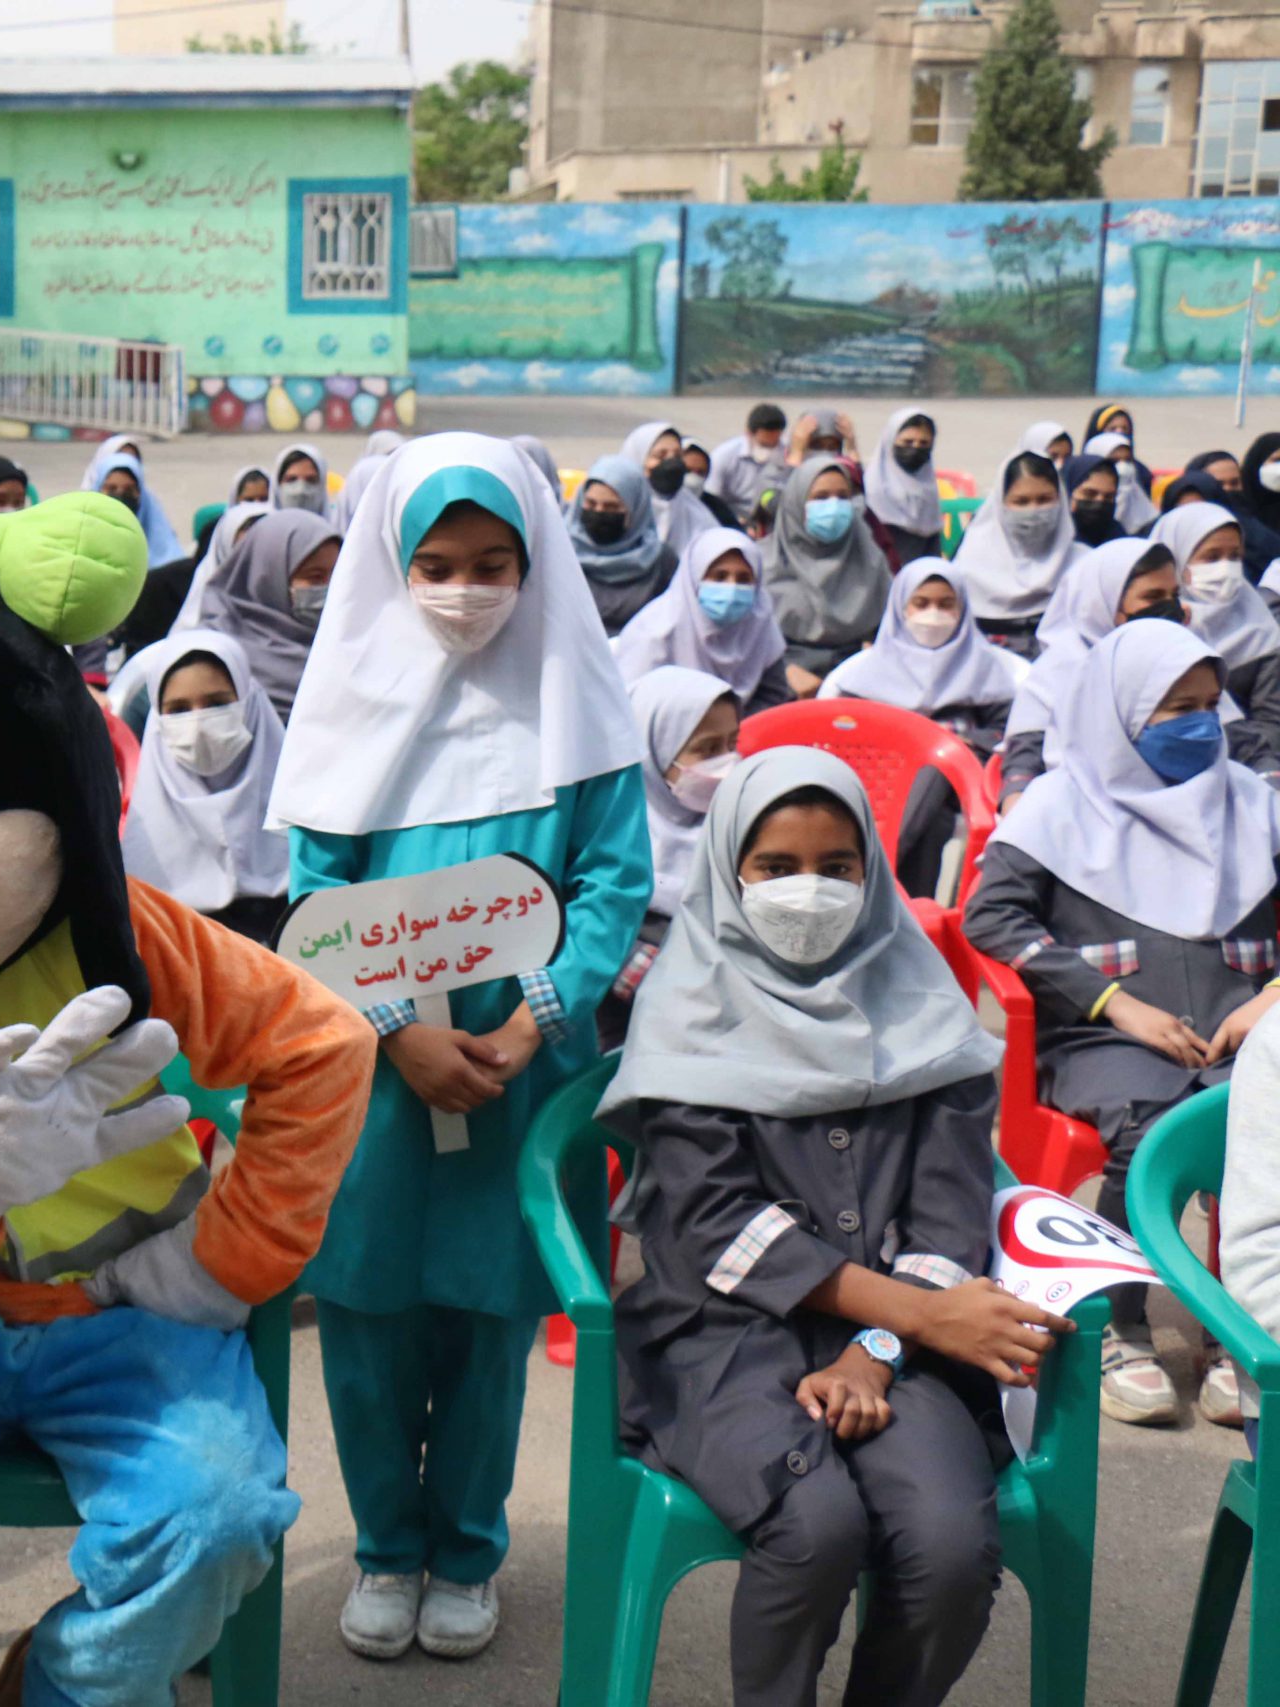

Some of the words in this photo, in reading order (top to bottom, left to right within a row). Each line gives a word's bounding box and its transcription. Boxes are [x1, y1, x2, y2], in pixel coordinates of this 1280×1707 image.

[446, 887, 543, 925] دوچرخه
[298, 920, 353, 959] ایمن
[360, 912, 439, 947] سواری
[353, 956, 406, 987] است
[414, 958, 448, 983] من
[455, 943, 494, 973] حق
